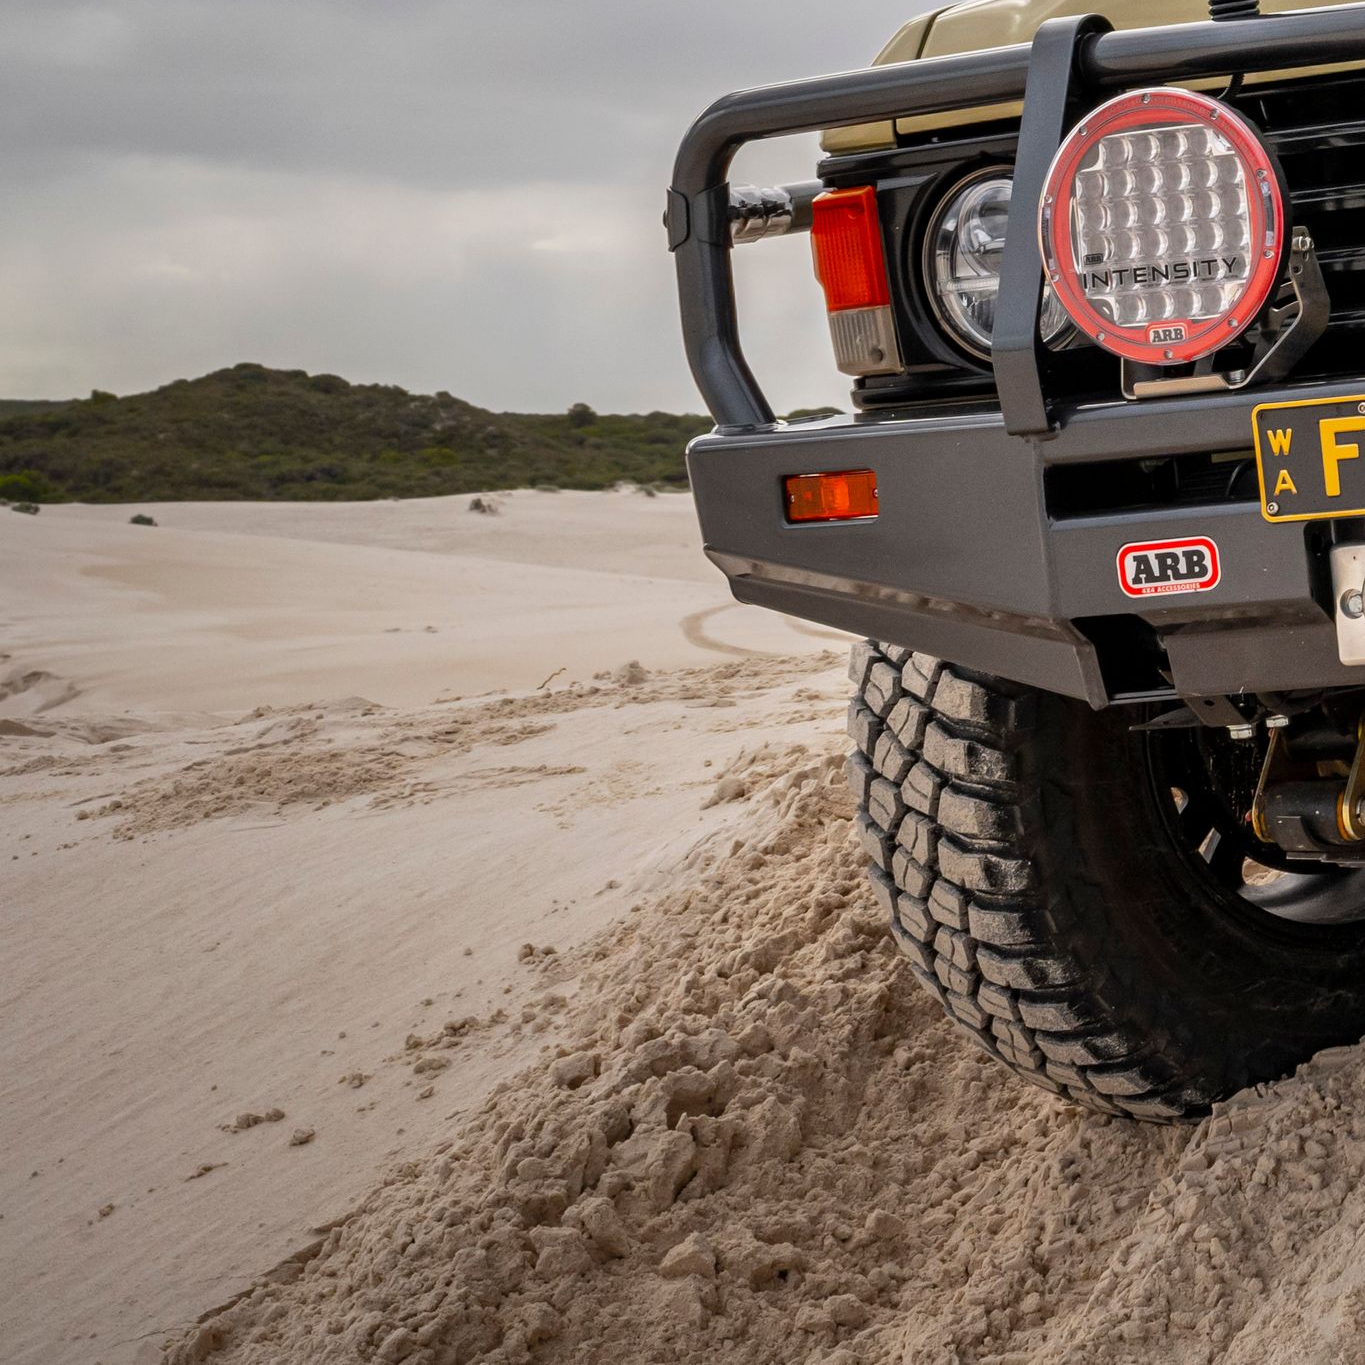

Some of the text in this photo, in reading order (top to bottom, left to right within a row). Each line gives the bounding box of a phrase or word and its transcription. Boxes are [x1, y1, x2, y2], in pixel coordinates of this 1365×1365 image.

[1082, 256, 1238, 290] INTENSITY
[1152, 327, 1184, 343] ARB
[1131, 549, 1209, 585] ARB
[1157, 582, 1201, 593] ACCESSORIES
